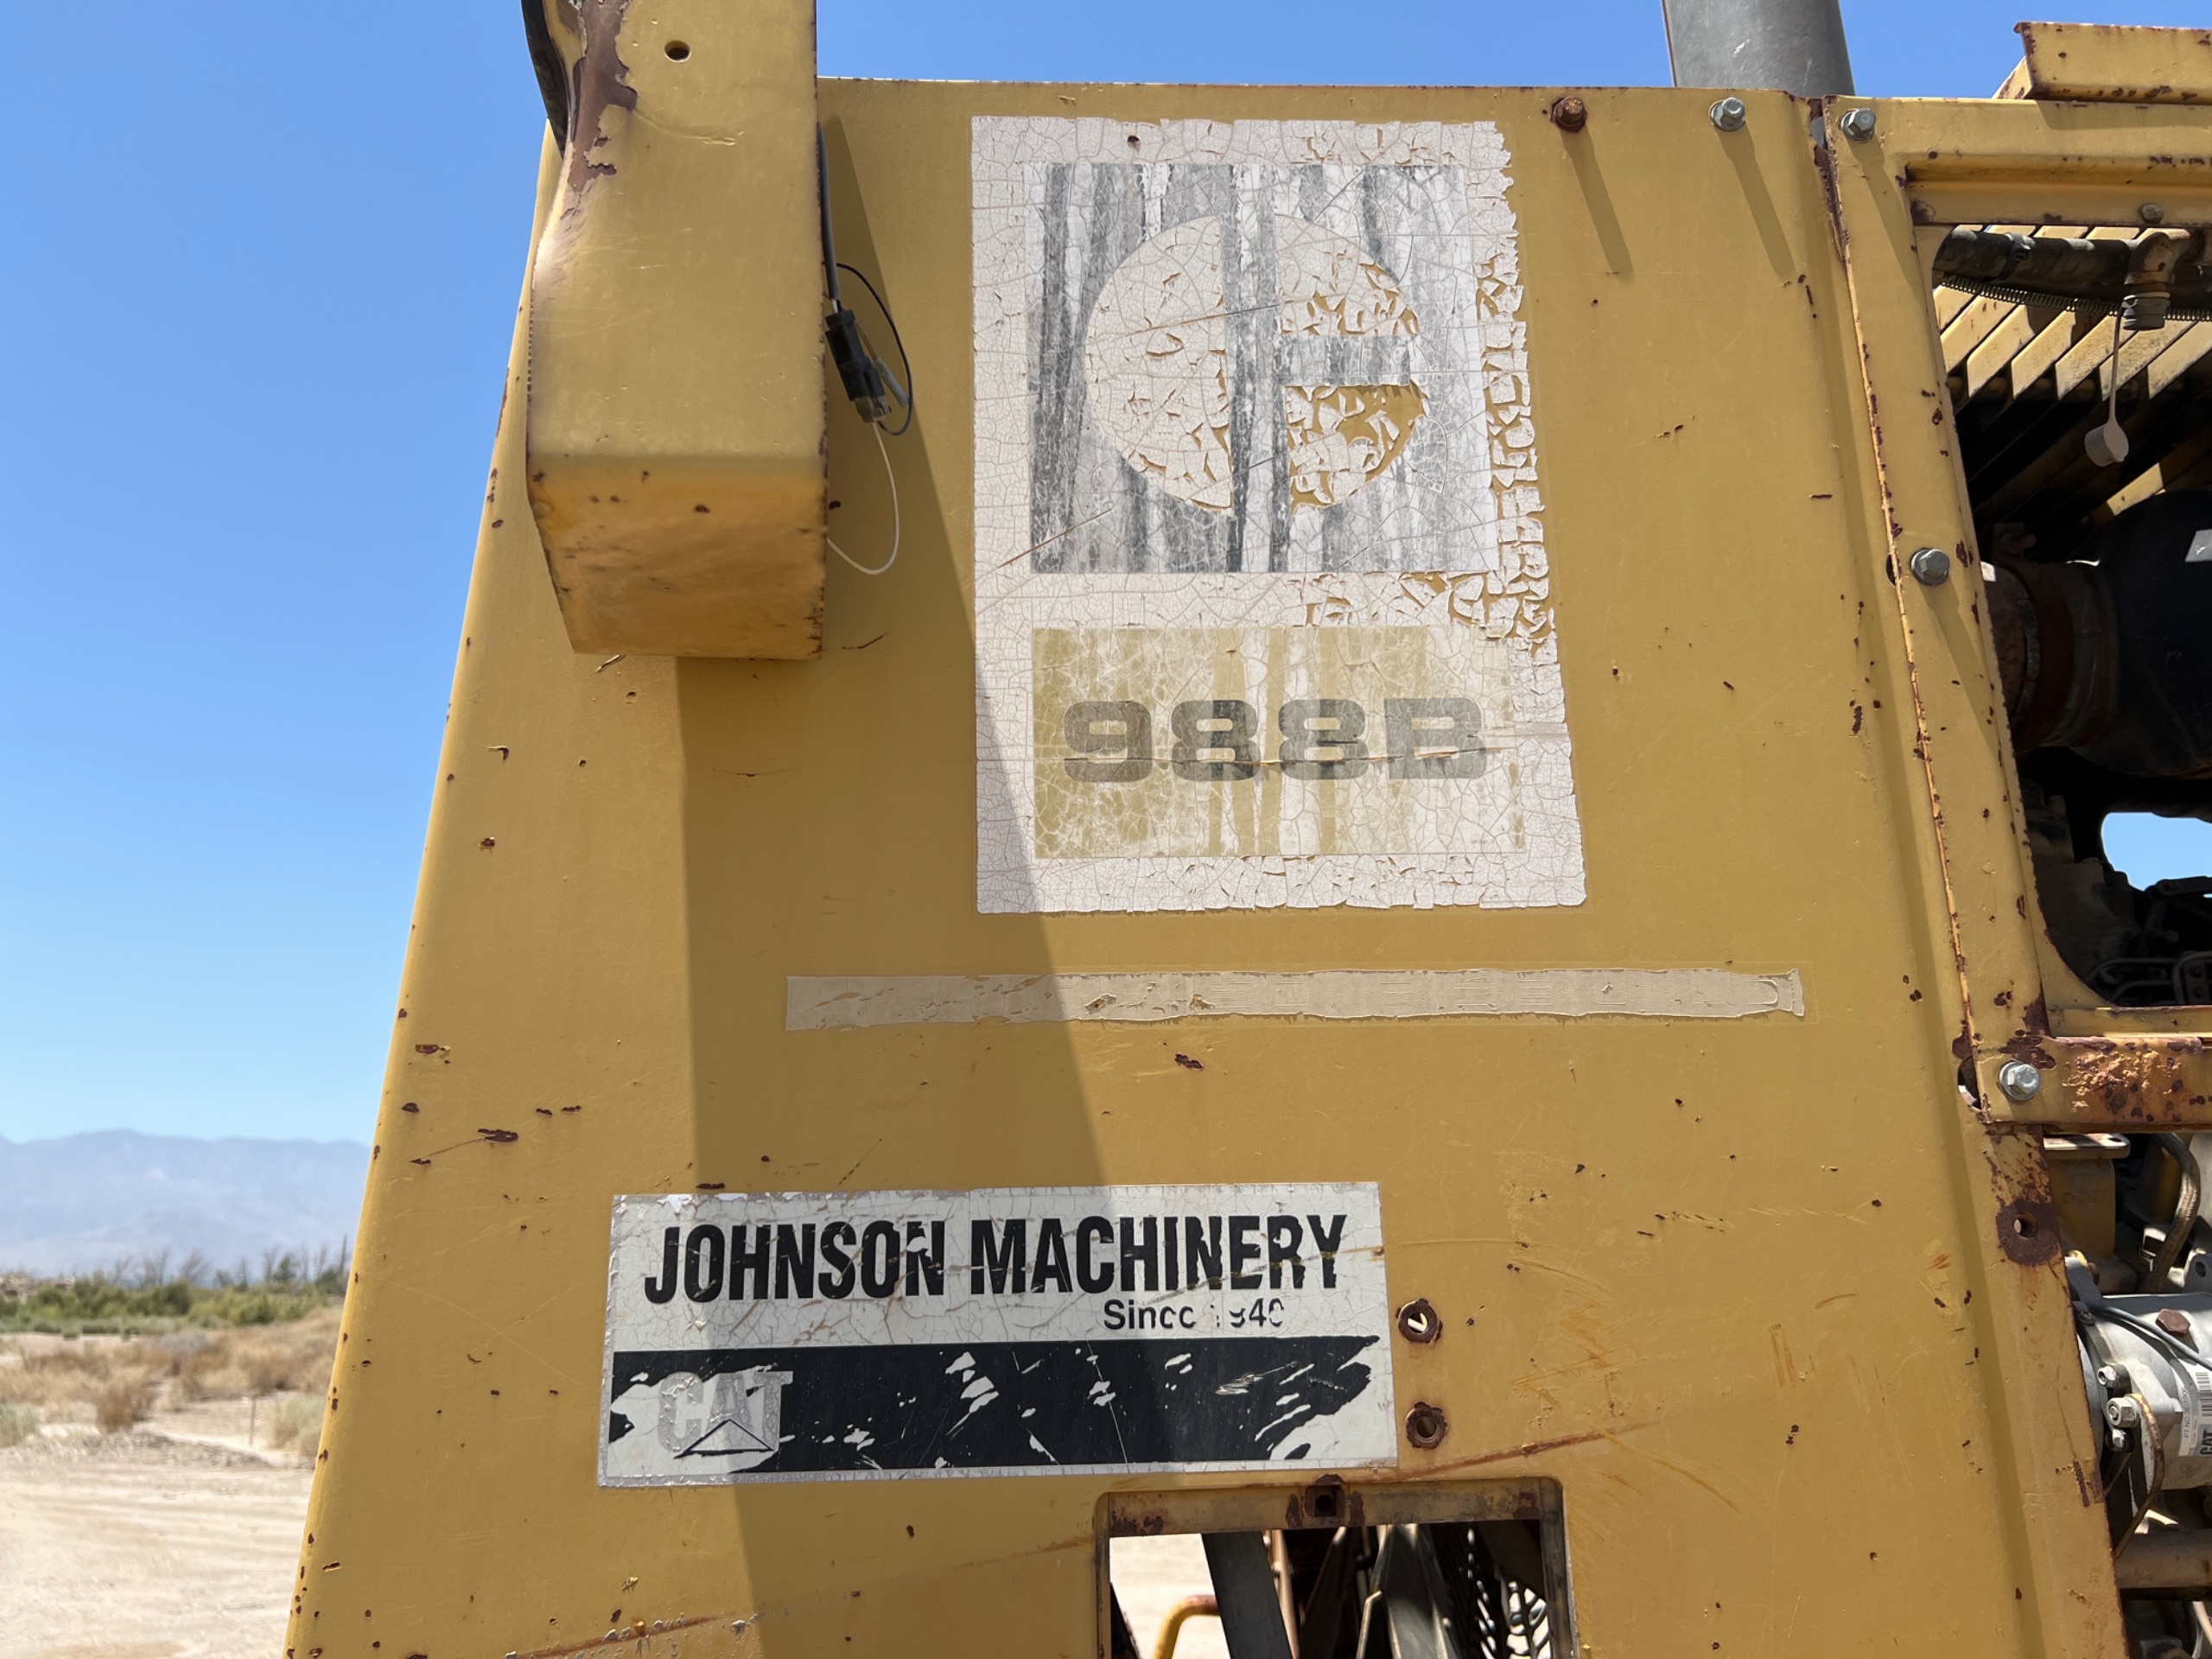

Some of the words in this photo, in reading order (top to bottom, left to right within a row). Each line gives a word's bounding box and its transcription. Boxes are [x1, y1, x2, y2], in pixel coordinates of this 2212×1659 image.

[1064, 698, 1487, 782] 988B
[644, 1220, 945, 1304] JOHNSON
[970, 1214, 1347, 1294] MACHINERY
[1210, 1298, 1285, 1328] 940
[658, 1370, 794, 1453] CAT
